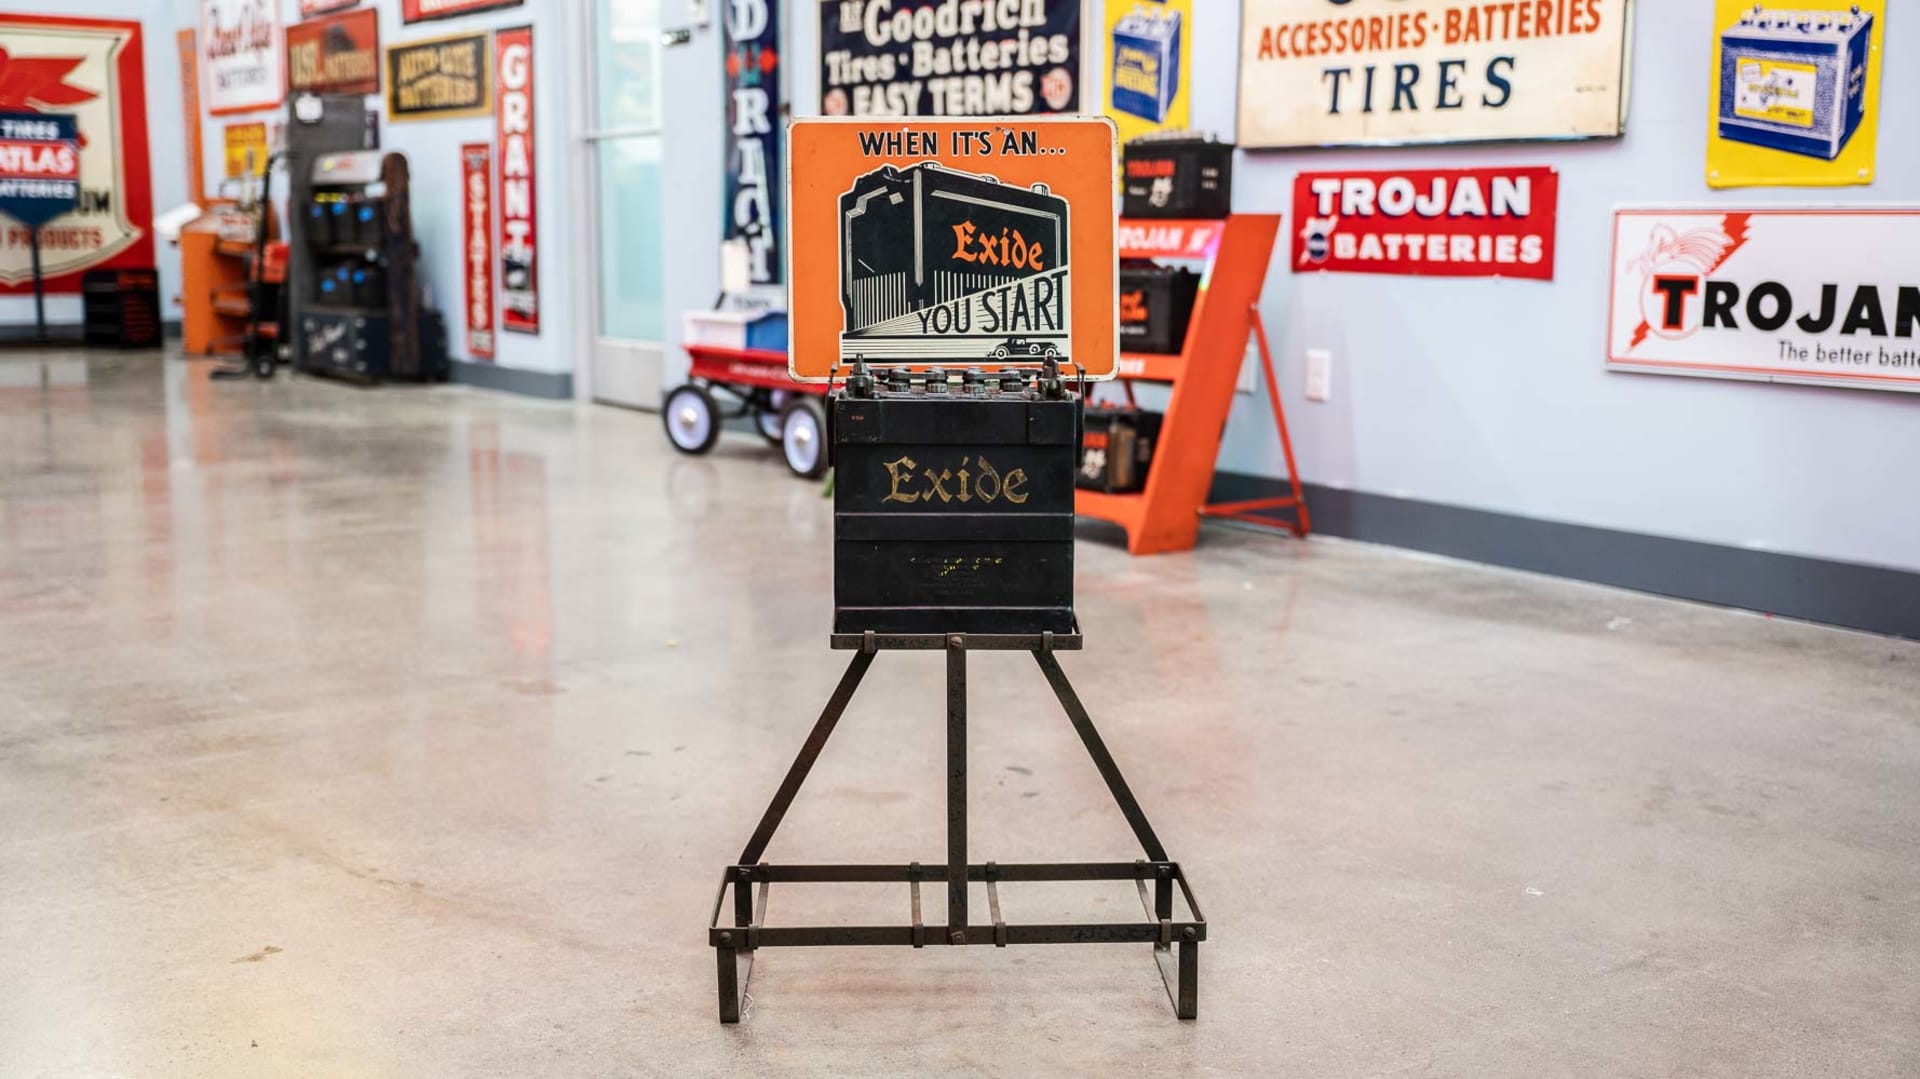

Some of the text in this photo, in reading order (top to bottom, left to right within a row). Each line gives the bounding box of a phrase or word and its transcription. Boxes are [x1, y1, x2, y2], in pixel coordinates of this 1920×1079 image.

[863, 0, 1047, 47] Goodrich
[1257, 0, 1602, 60] ACCESSORIES BATTERIES
[824, 50, 895, 86] Tires
[911, 28, 1069, 77] Batteries
[852, 80, 922, 116] EASY
[928, 70, 1034, 116] TERMS
[1322, 55, 1516, 114] TIRES
[3, 120, 60, 140] TIRES
[859, 131, 937, 156] WHEN
[952, 131, 992, 156] IT'S
[0, 182, 77, 199] ATTERIES
[1312, 176, 1531, 217] TROJAN
[952, 219, 1044, 270] Exide
[1119, 226, 1184, 250] ROJAN
[1334, 233, 1543, 264] BATTERIES
[917, 299, 971, 333] YOU
[980, 270, 1068, 333] START
[1653, 274, 1920, 337] TROJAN
[1778, 339, 1809, 361] The
[1816, 342, 1870, 365] better
[882, 456, 1029, 503] Exide
